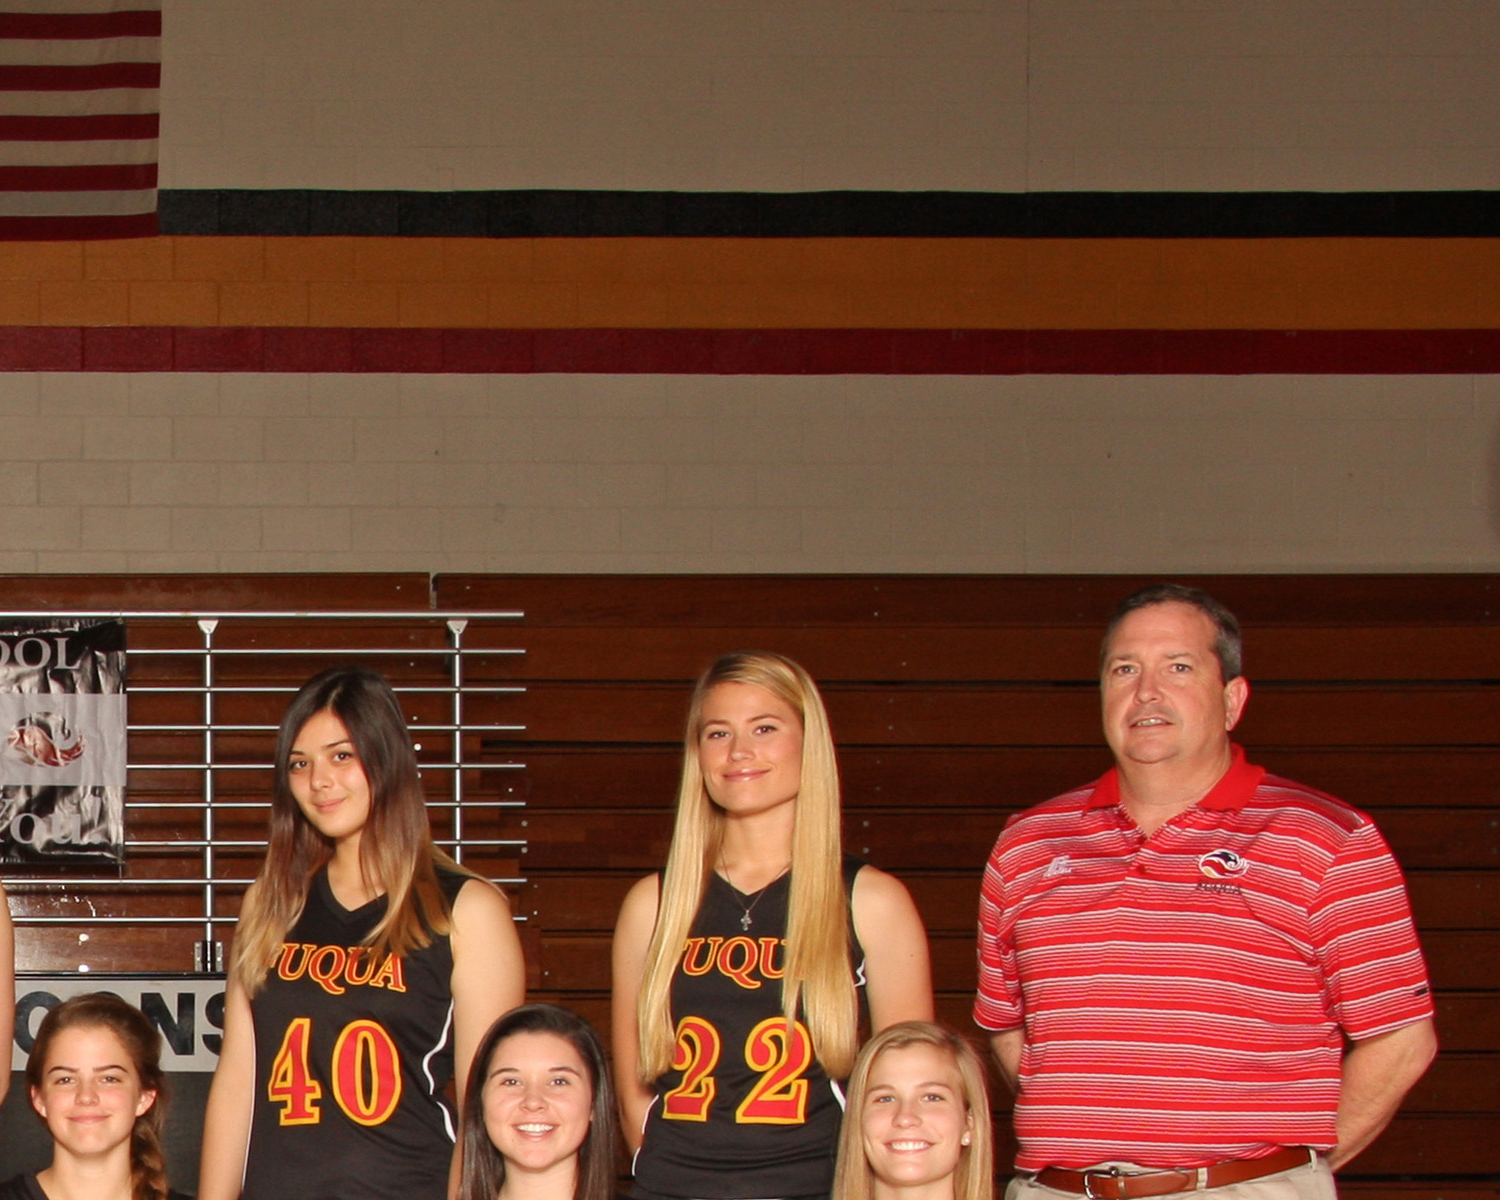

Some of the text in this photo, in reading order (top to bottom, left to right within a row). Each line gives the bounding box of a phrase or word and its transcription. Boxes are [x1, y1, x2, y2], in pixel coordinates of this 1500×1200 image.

[266, 943, 407, 995] UQUA
[682, 936, 788, 989] UQU
[268, 1017, 402, 1126] 40
[662, 1016, 812, 1124] 22
